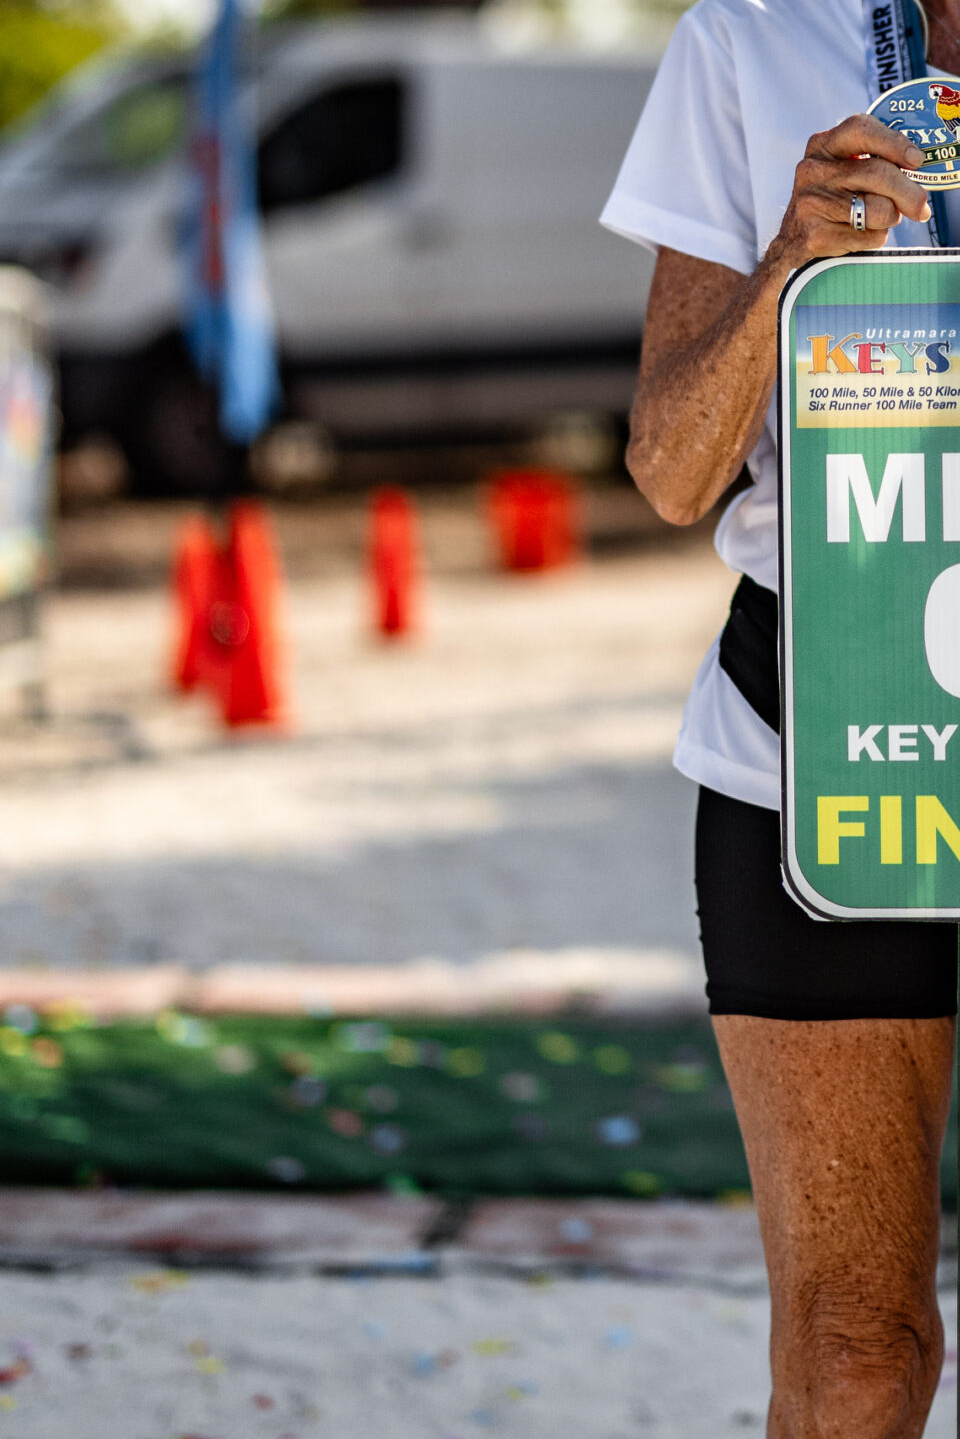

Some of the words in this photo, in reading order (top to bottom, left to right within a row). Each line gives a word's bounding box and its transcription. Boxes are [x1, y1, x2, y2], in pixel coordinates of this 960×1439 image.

[873, 5, 899, 92] FINISHER
[889, 99, 925, 112] 2024
[935, 147, 956, 160] 100
[941, 173, 958, 181] MILE
[809, 388, 829, 398] 100
[832, 387, 858, 399] Mile,
[862, 387, 876, 397] 50
[880, 387, 903, 397] Mile
[907, 387, 915, 397] &
[918, 386, 932, 397] 50
[808, 401, 825, 411] Six
[829, 401, 872, 410] Runner
[876, 400, 895, 410] 100
[898, 400, 922, 410] Mile
[926, 399, 957, 409] Team
[847, 724, 958, 761] KEY
